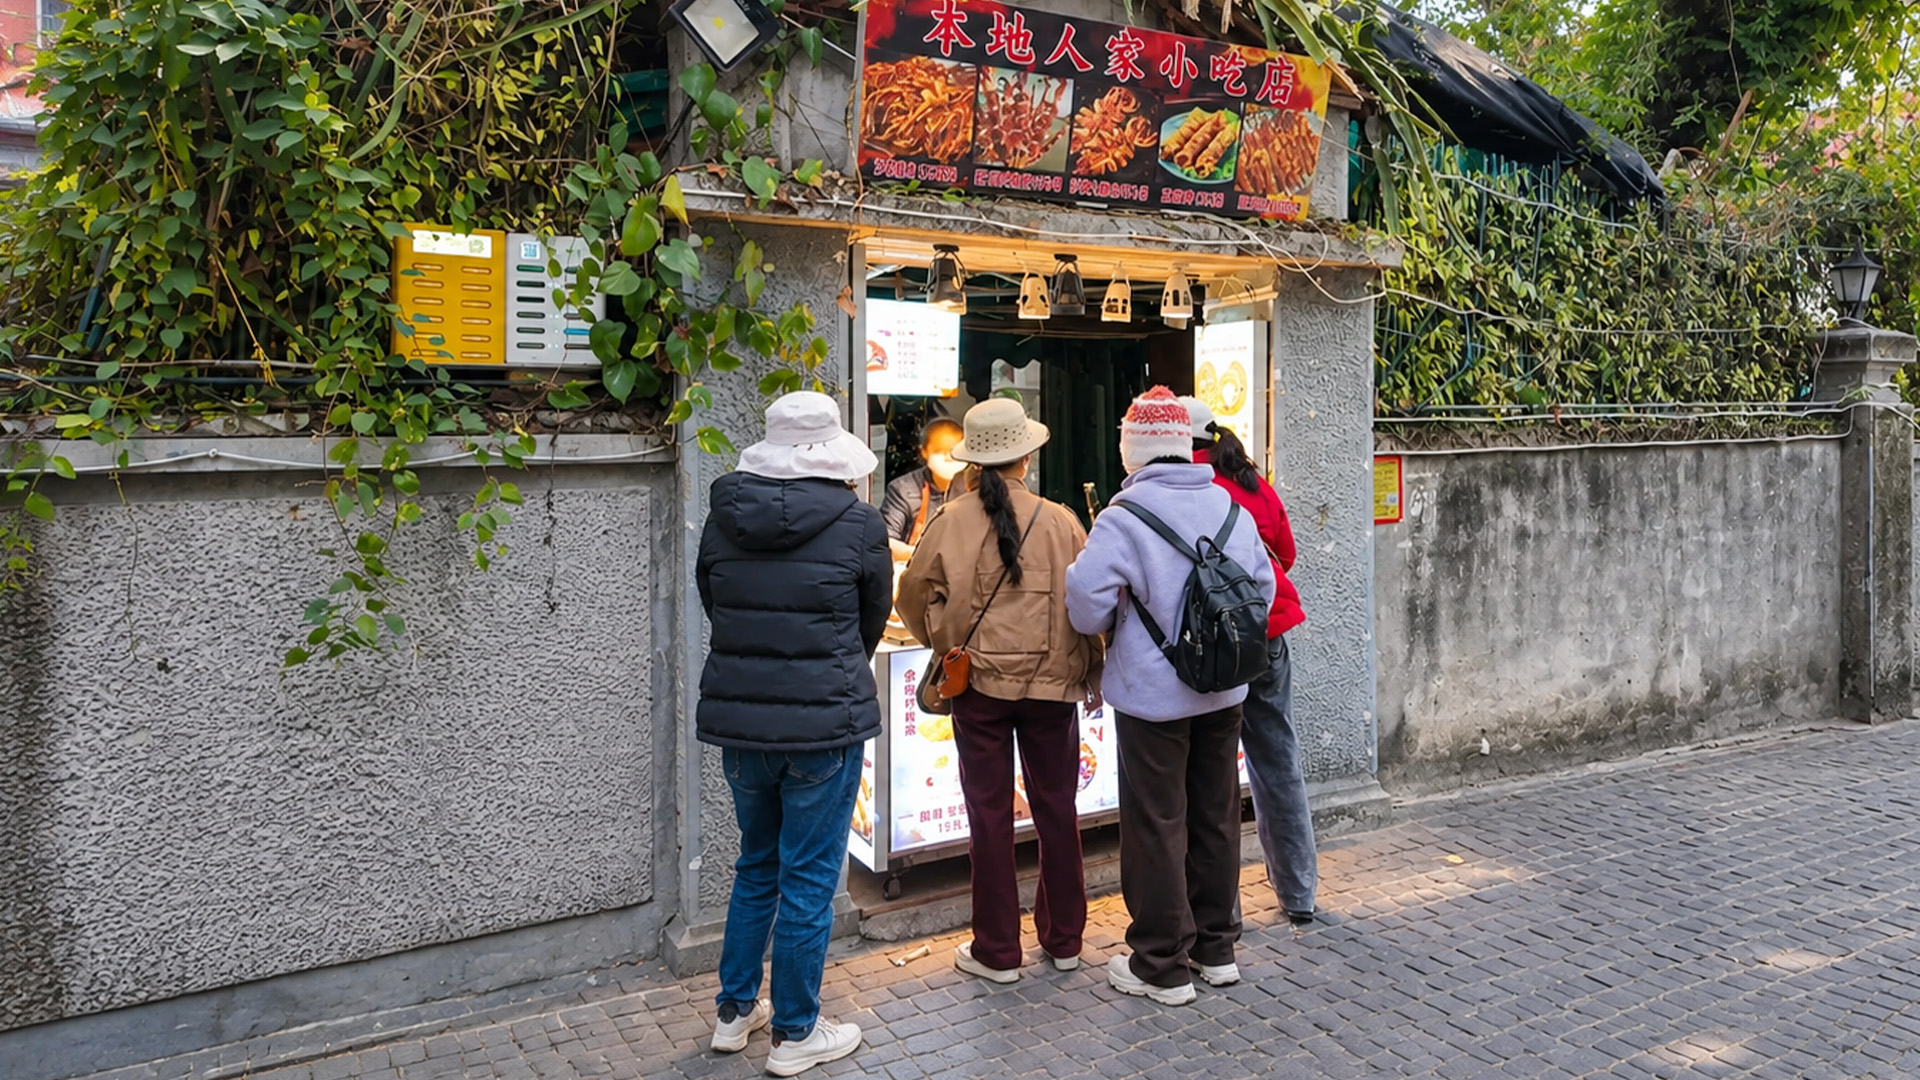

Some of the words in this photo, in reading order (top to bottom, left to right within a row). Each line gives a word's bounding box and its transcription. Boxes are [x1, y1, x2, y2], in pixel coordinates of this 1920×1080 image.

[923, 0, 1295, 104] 本地人家小吃店
